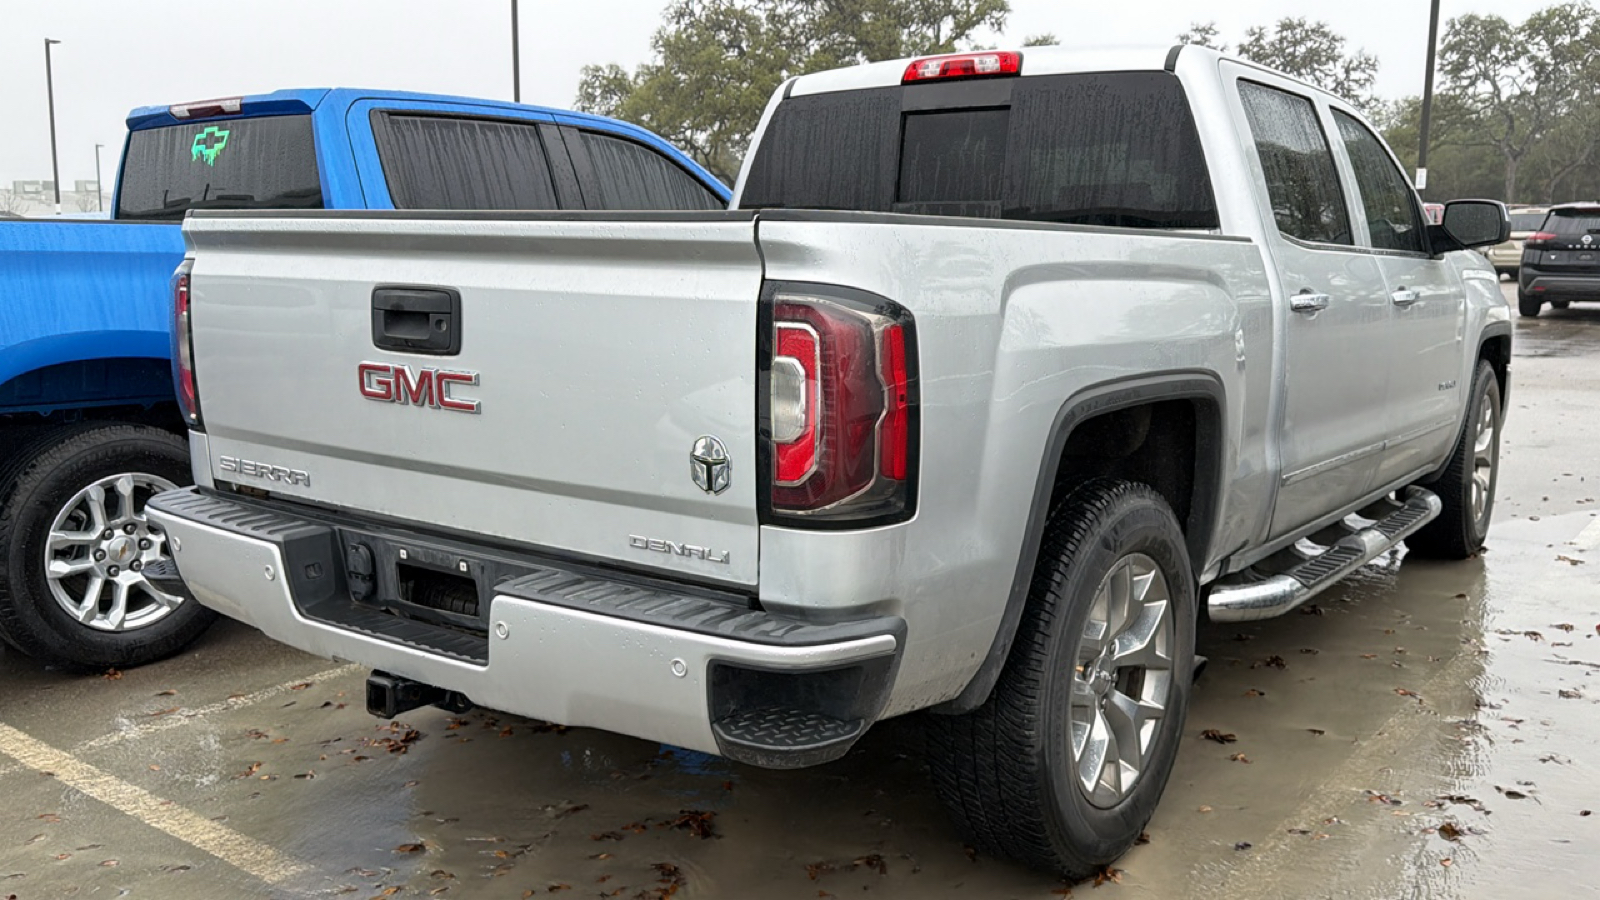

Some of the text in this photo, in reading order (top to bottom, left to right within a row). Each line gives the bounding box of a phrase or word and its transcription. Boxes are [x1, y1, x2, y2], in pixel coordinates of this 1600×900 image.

[358, 360, 481, 414] GMC
[220, 455, 310, 487] SIERRA
[629, 534, 730, 564] DENALI
